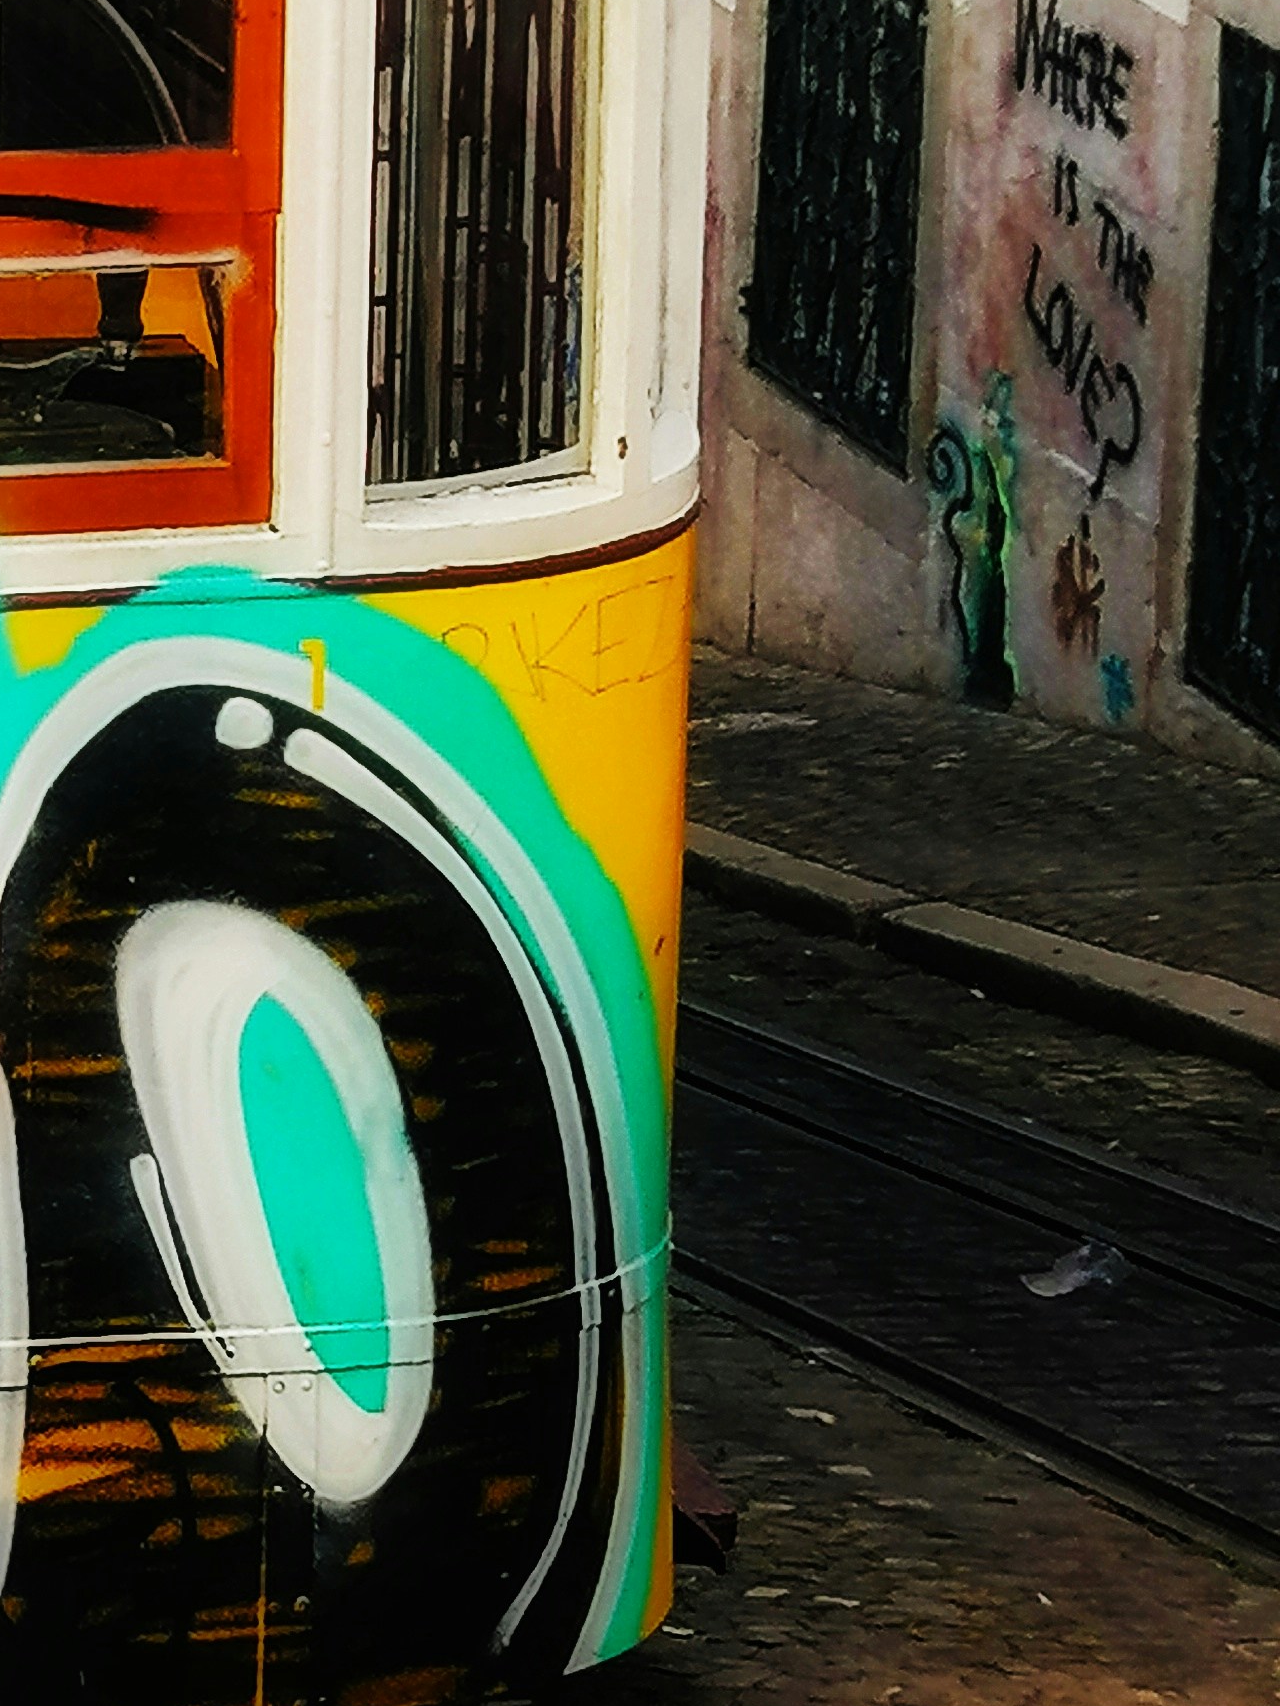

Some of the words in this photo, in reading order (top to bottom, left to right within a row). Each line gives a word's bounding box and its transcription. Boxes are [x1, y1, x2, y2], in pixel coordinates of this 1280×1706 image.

[1052, 152, 1079, 227] IS
[1093, 199, 1155, 329] THE
[1023, 242, 1142, 501] LOVE?
